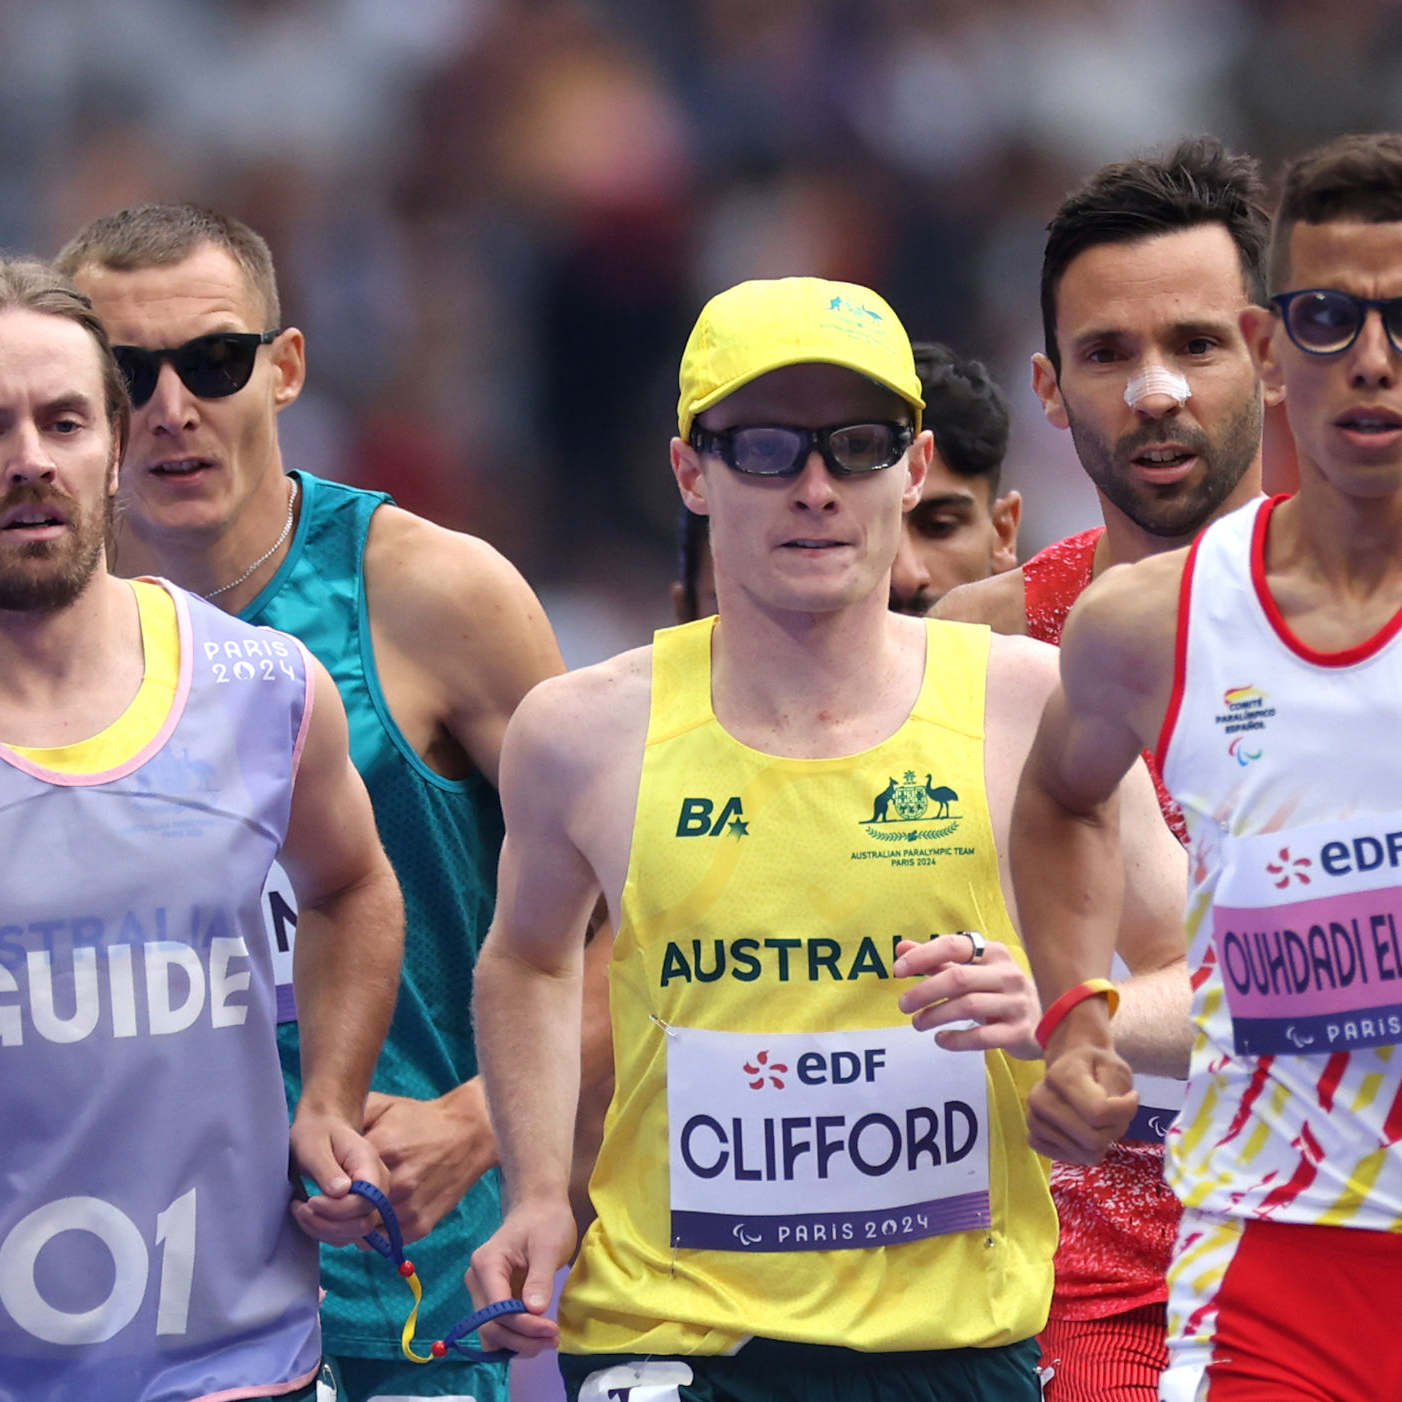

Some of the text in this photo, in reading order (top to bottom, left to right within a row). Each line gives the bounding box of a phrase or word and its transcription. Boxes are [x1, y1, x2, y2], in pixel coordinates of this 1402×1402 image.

[203, 639, 288, 660] PARIS
[212, 660, 295, 683] 2024
[851, 847, 975, 860] AUSTRALIAN PARALYMPIC TEAM
[891, 858, 936, 867] PARIS 2024
[1224, 918, 1368, 996] OUHDADI
[1326, 1017, 1402, 1044] PARIS
[680, 1100, 979, 1182] CLIFFORD
[777, 1213, 930, 1245] PARIS 2024
